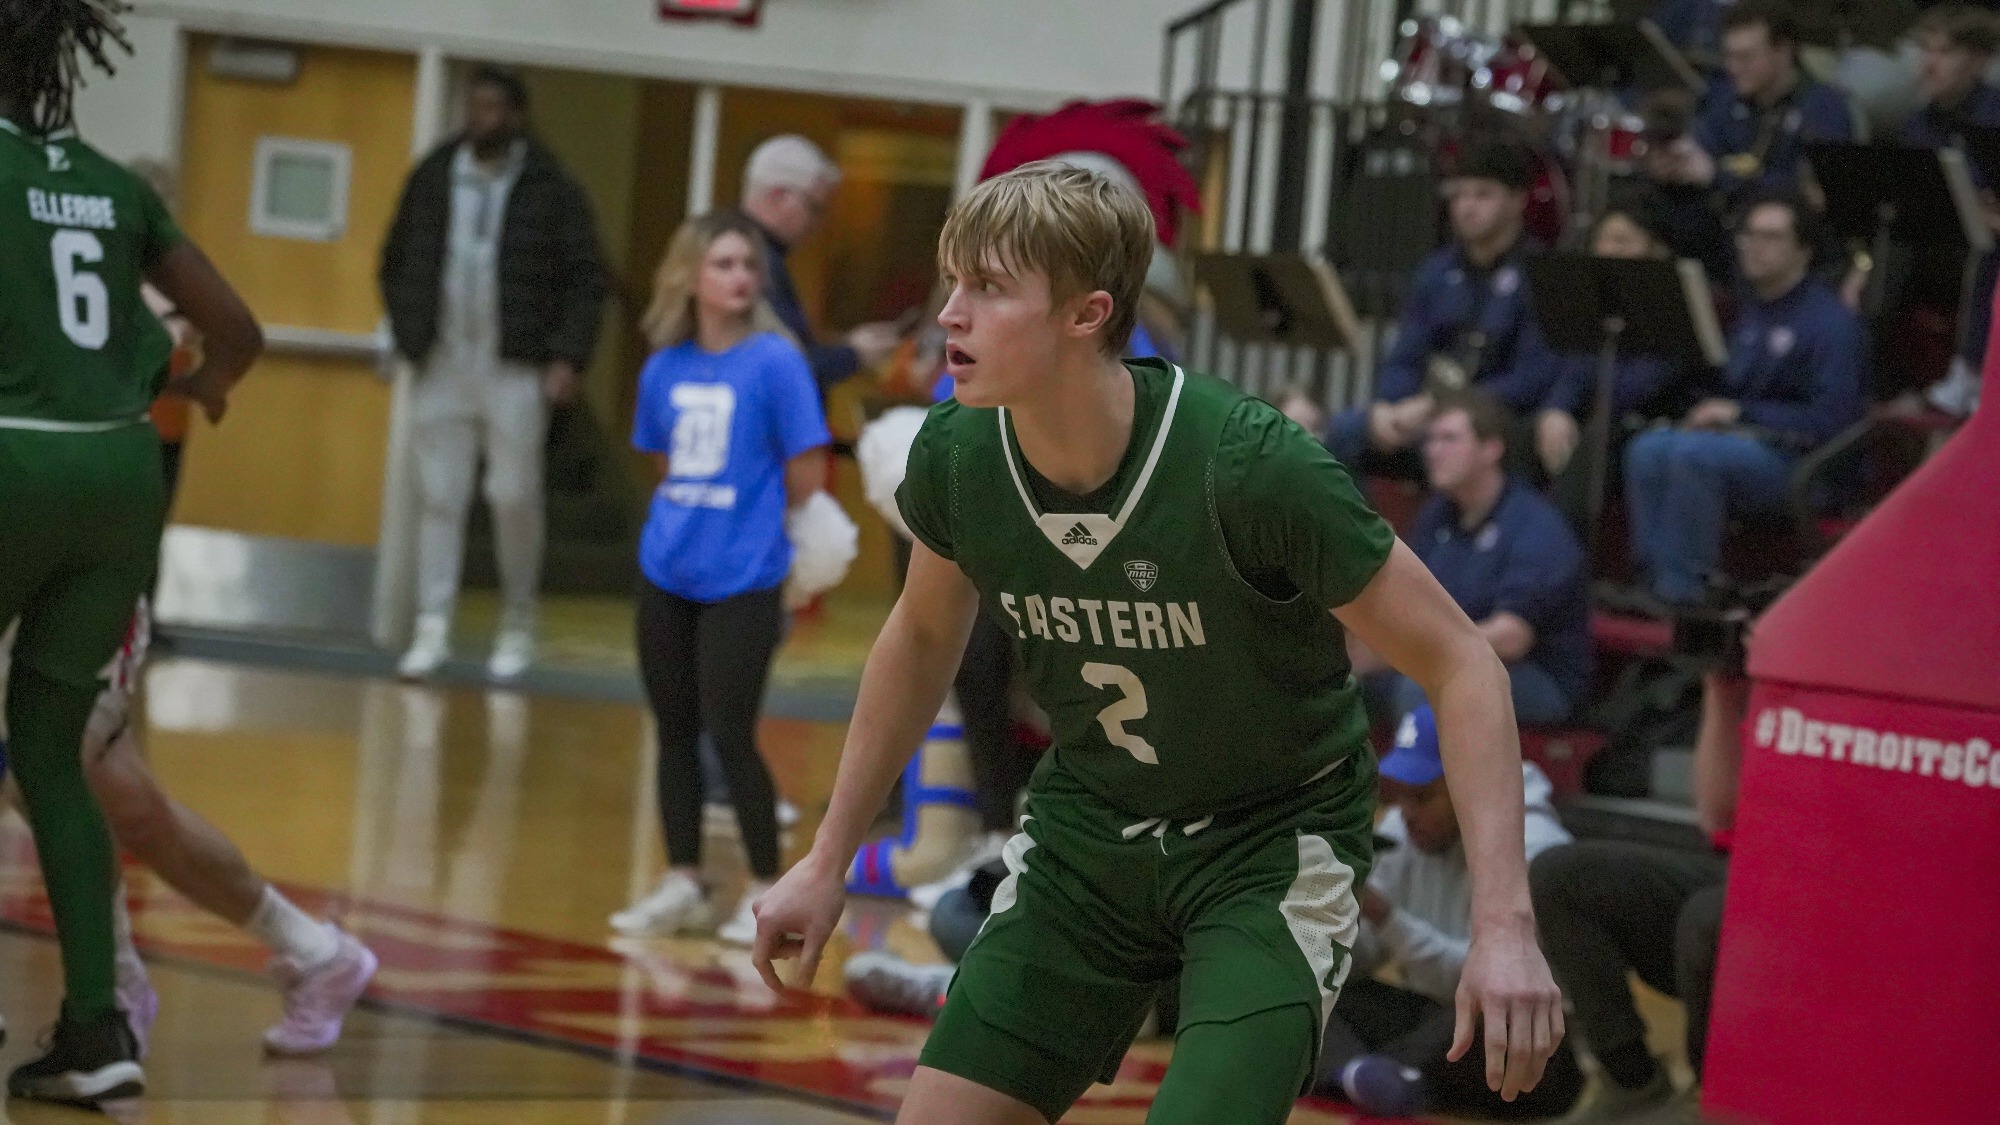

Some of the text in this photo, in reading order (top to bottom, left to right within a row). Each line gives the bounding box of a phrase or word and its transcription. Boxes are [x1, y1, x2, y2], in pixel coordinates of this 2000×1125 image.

[51, 228, 109, 350] 6
[1062, 535, 1098, 545] adidas
[1129, 570, 1157, 579] MAC
[1080, 661, 1160, 765] 2
